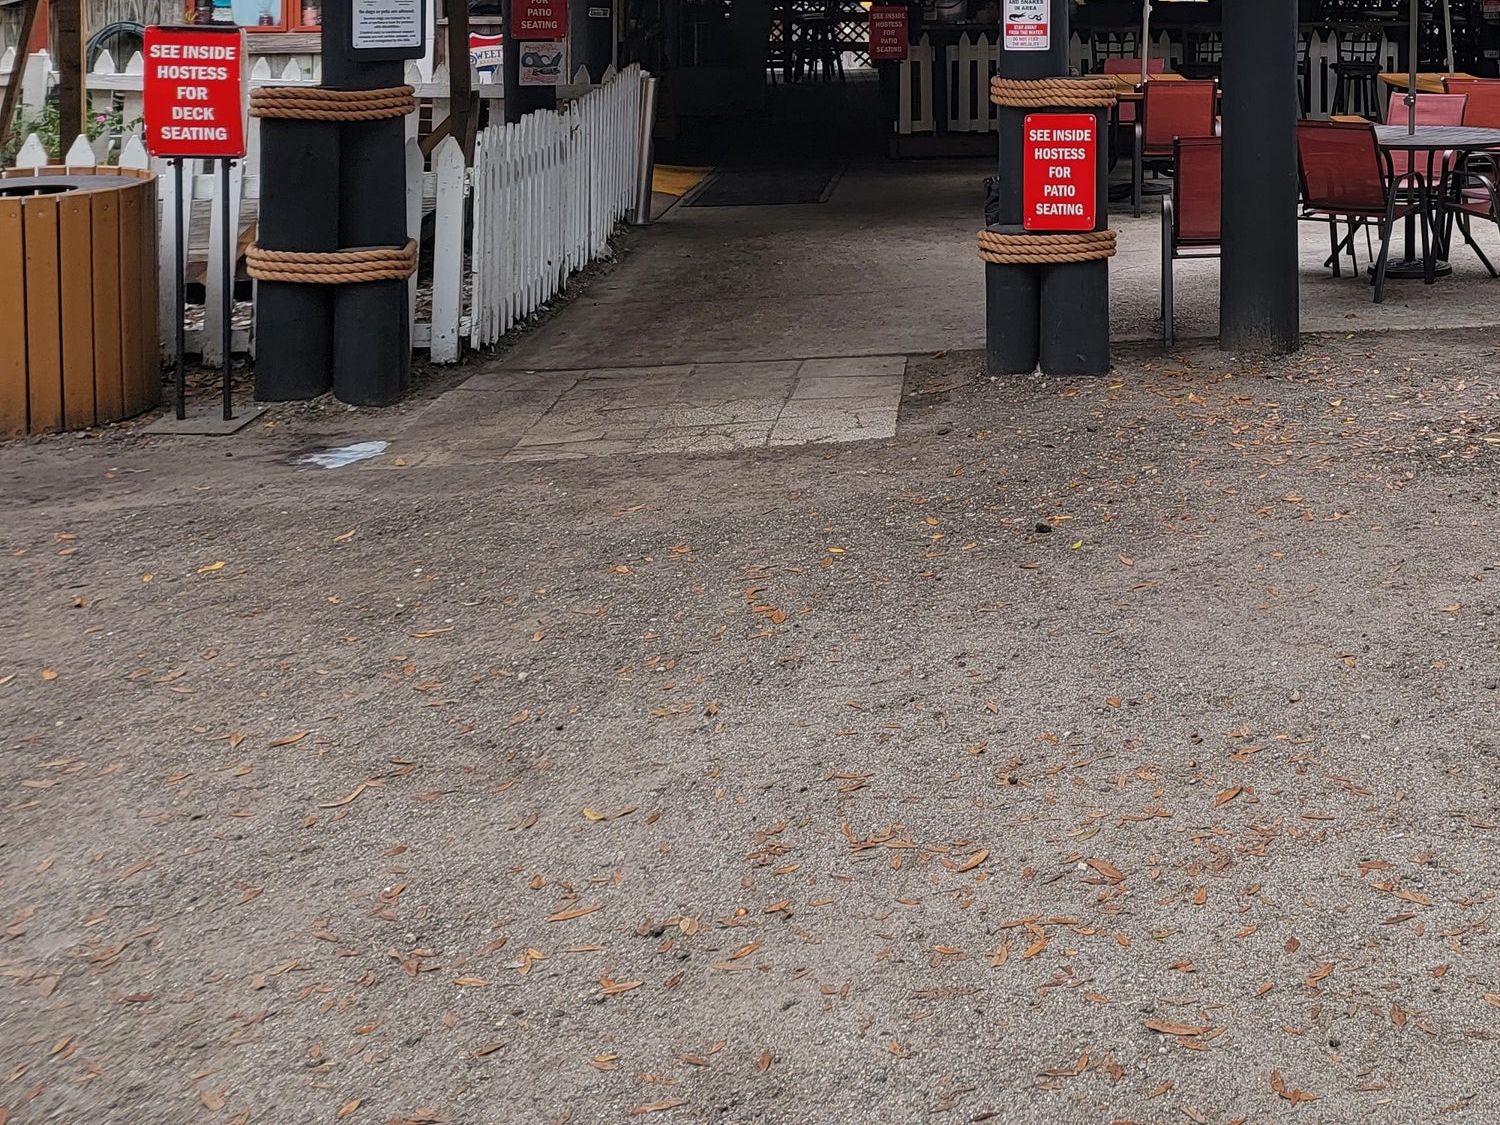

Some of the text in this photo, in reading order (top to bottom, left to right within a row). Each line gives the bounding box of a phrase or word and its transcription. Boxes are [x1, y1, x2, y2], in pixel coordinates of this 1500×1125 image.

[528, 8, 551, 16] PATIO
[521, 21, 558, 29] SEATING
[150, 45, 236, 60] SEE INSIDE
[157, 66, 227, 80] HOSTESS
[177, 86, 208, 100] FOR
[172, 107, 215, 121] DECK
[161, 127, 227, 141] SEATING
[1029, 130, 1091, 141] SEE INSIDE
[1034, 148, 1086, 160] HOSTESS
[1049, 166, 1071, 178] FOR
[1044, 185, 1076, 197] PATIO
[1036, 203, 1084, 215] SEATING
